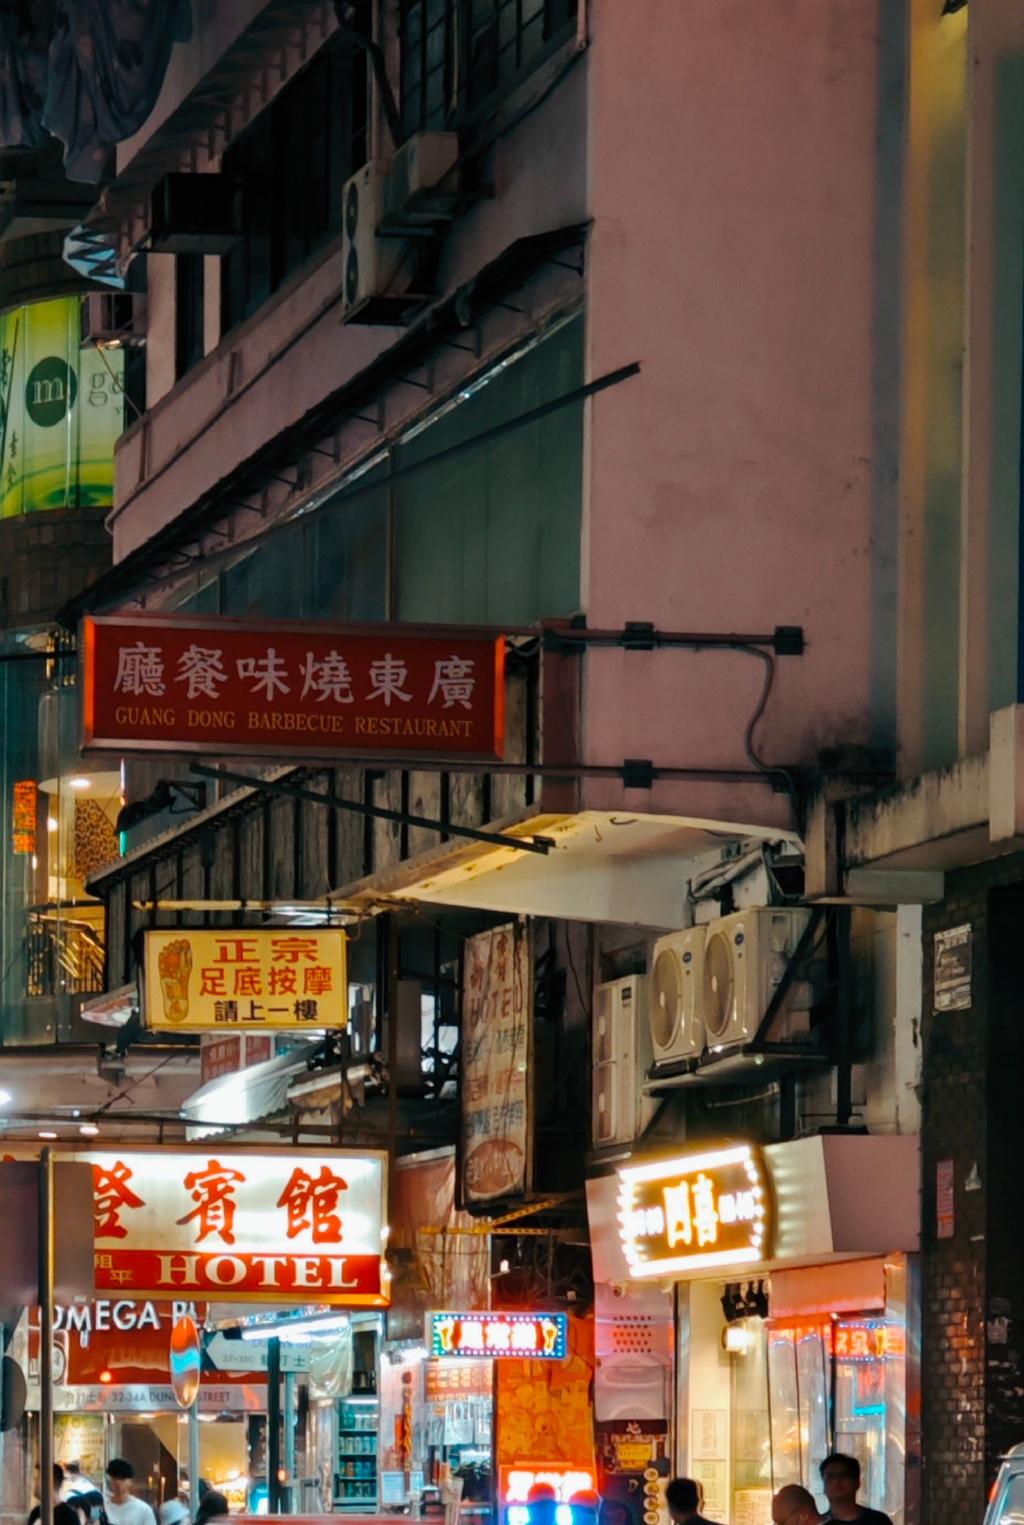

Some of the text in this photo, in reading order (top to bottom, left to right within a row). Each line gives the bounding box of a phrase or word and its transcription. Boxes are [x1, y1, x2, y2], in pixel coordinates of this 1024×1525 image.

[115, 706, 474, 738] GUANG DONG BARBECUE RESTAURANT
[213, 937, 318, 964] 正宗
[199, 966, 332, 997] 足底按摩
[214, 999, 318, 1022] 請上一樓
[156, 1255, 359, 1288] HOTEL
